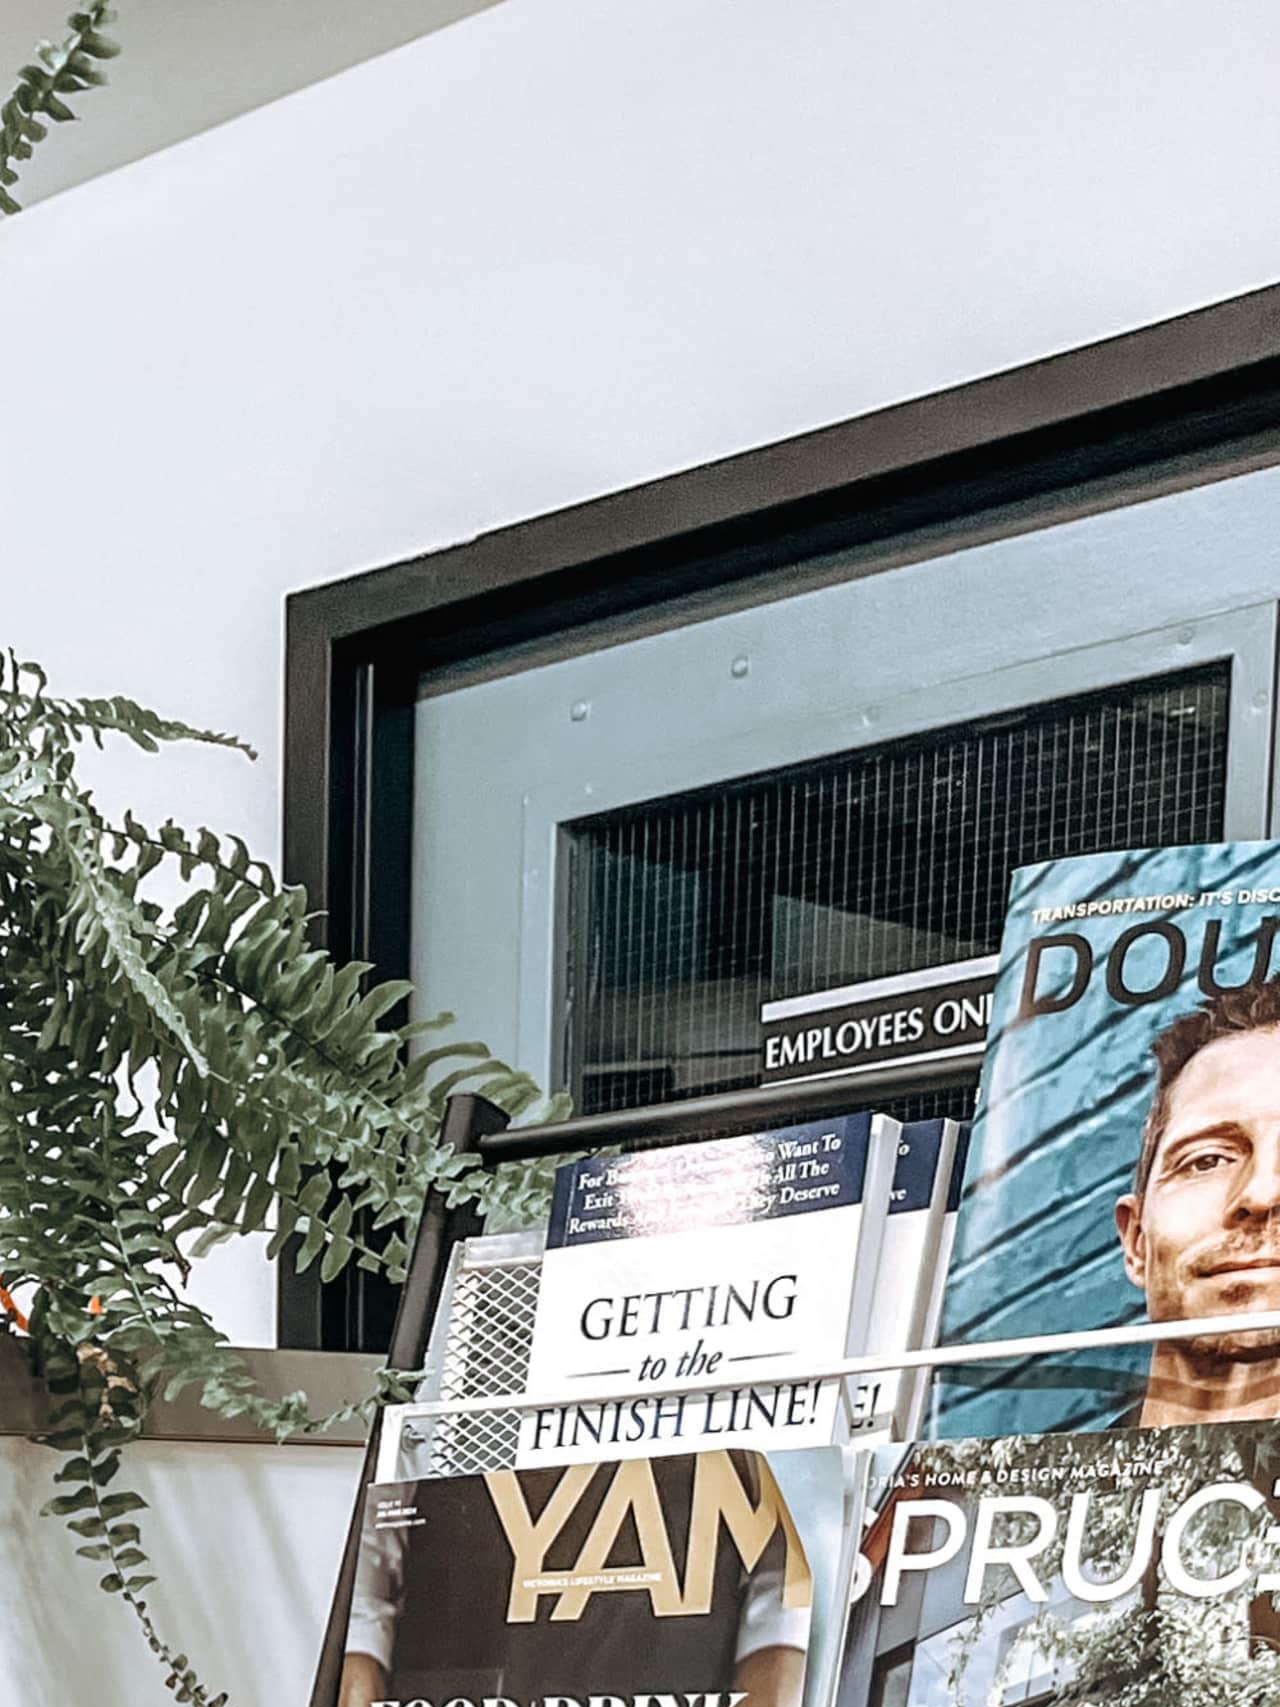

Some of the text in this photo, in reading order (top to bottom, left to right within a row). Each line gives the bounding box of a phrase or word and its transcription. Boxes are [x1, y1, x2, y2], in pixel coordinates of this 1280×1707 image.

[1032, 889, 1232, 925] TRANSPORTATION: IT'S
[765, 1006, 923, 1070] EMPLOYEES
[578, 1133, 841, 1190] For Want To
[584, 1160, 829, 1210] Exit All The
[780, 1183, 840, 1204] Deserve
[579, 1274, 798, 1340] GETTING
[638, 1339, 723, 1382] to the
[533, 1395, 687, 1449] FINISH
[702, 1380, 823, 1435] LINE!
[925, 1461, 1166, 1486] HOME DESIGN MAGAZINE
[484, 1449, 813, 1623] YAM
